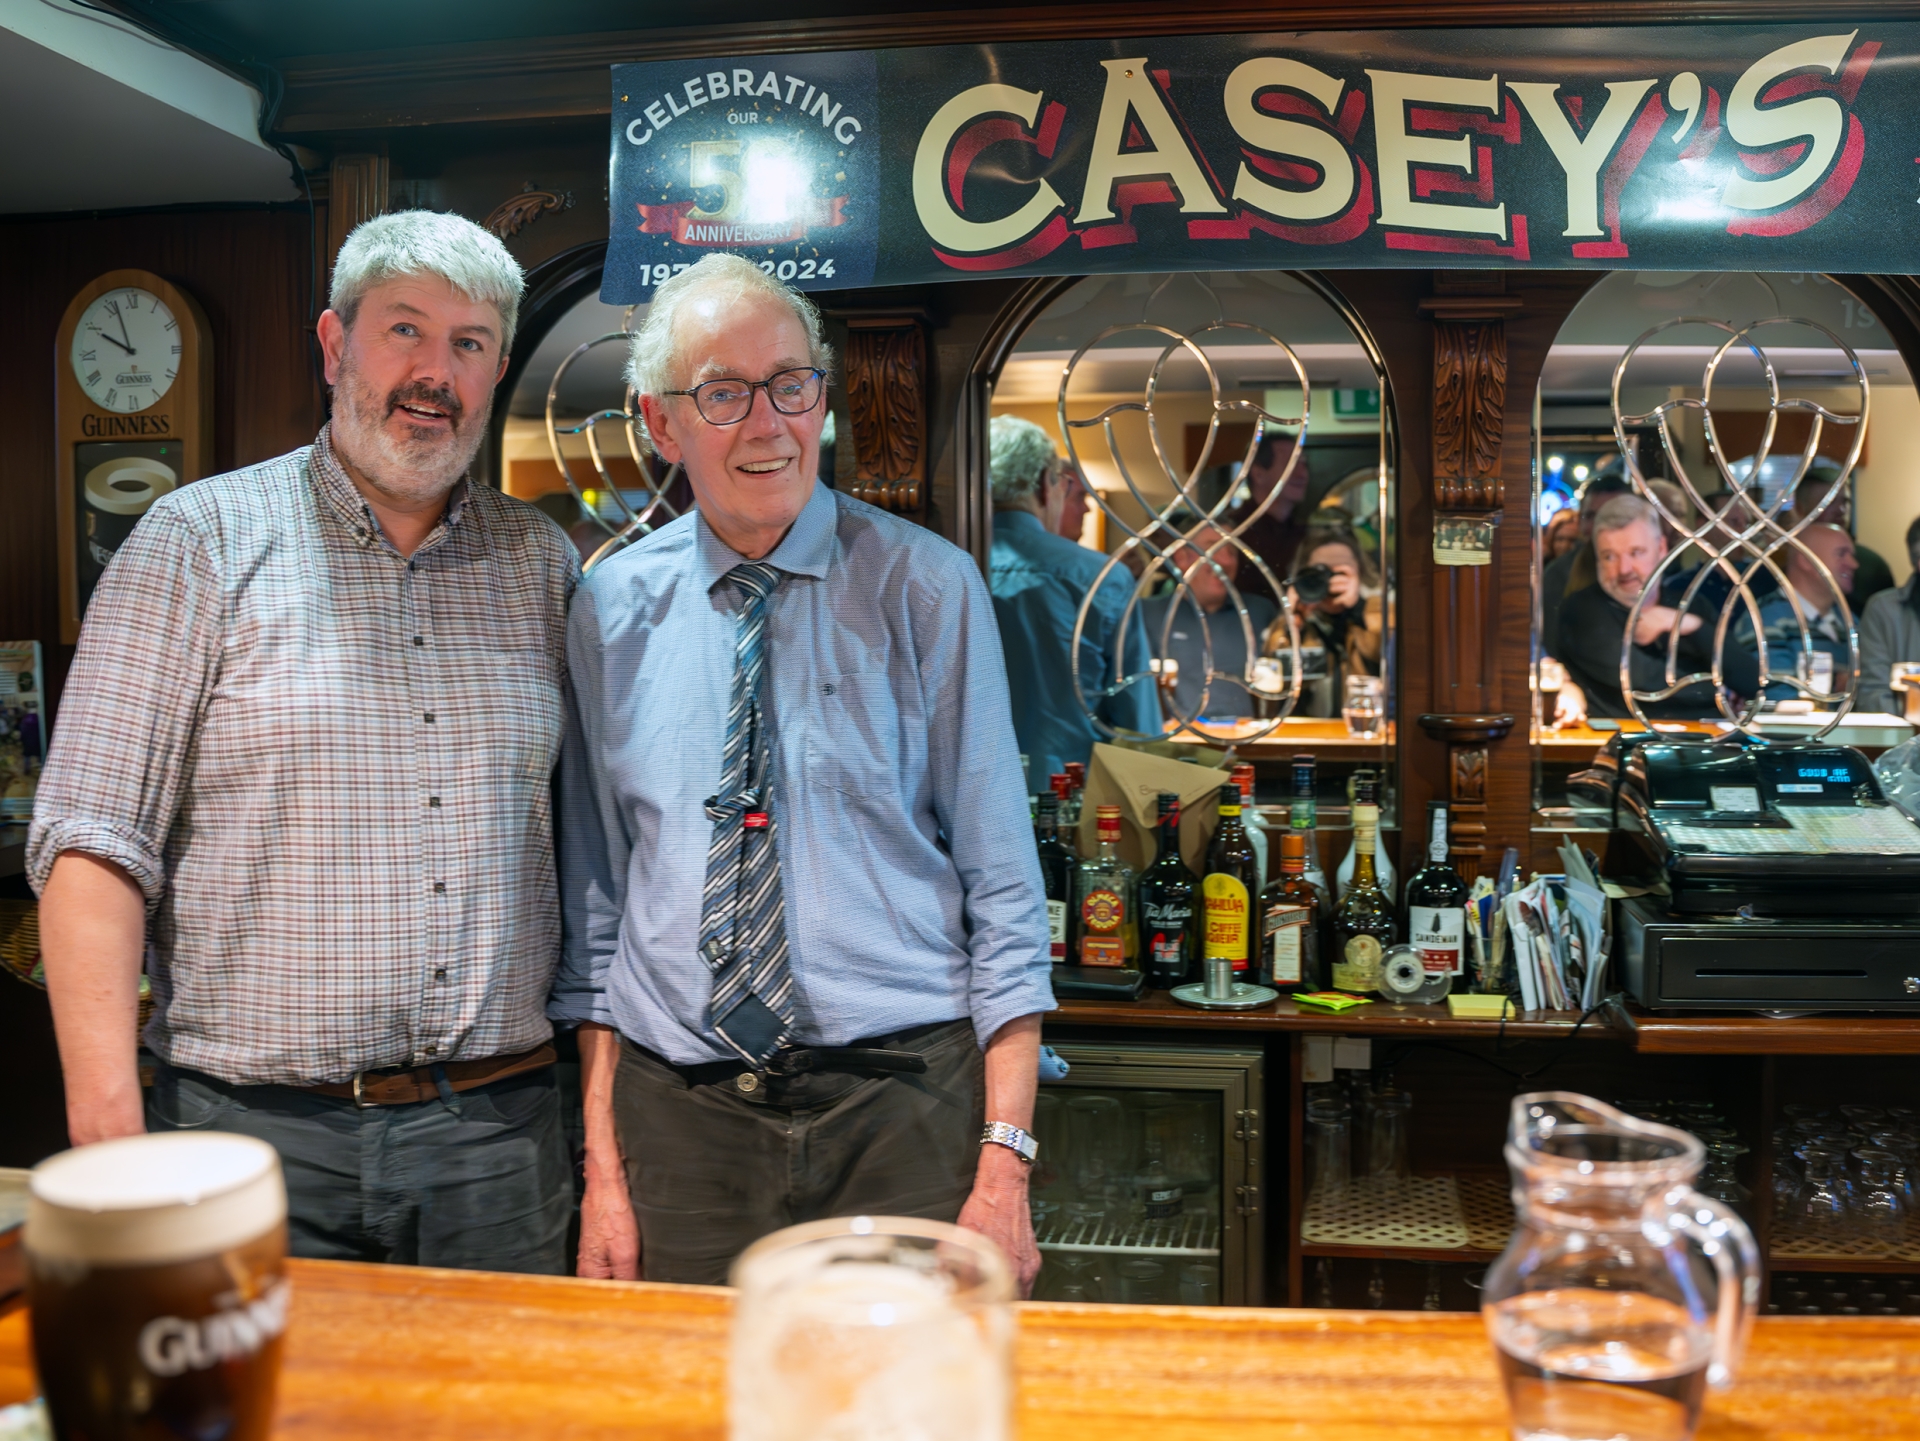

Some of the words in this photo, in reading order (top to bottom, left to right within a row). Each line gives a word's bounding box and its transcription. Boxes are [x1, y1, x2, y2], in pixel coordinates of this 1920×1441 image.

[626, 68, 862, 145] CELEBRATING
[727, 112, 759, 125] OUR
[912, 28, 1860, 253] CASEY'S
[684, 223, 793, 243] ANNIVERSARY
[640, 263, 691, 287] 197
[758, 258, 836, 281] 2024
[115, 374, 153, 385] GUINNESS
[81, 413, 171, 437] GUINNESS
[1415, 932, 1459, 944] SANDEMAN
